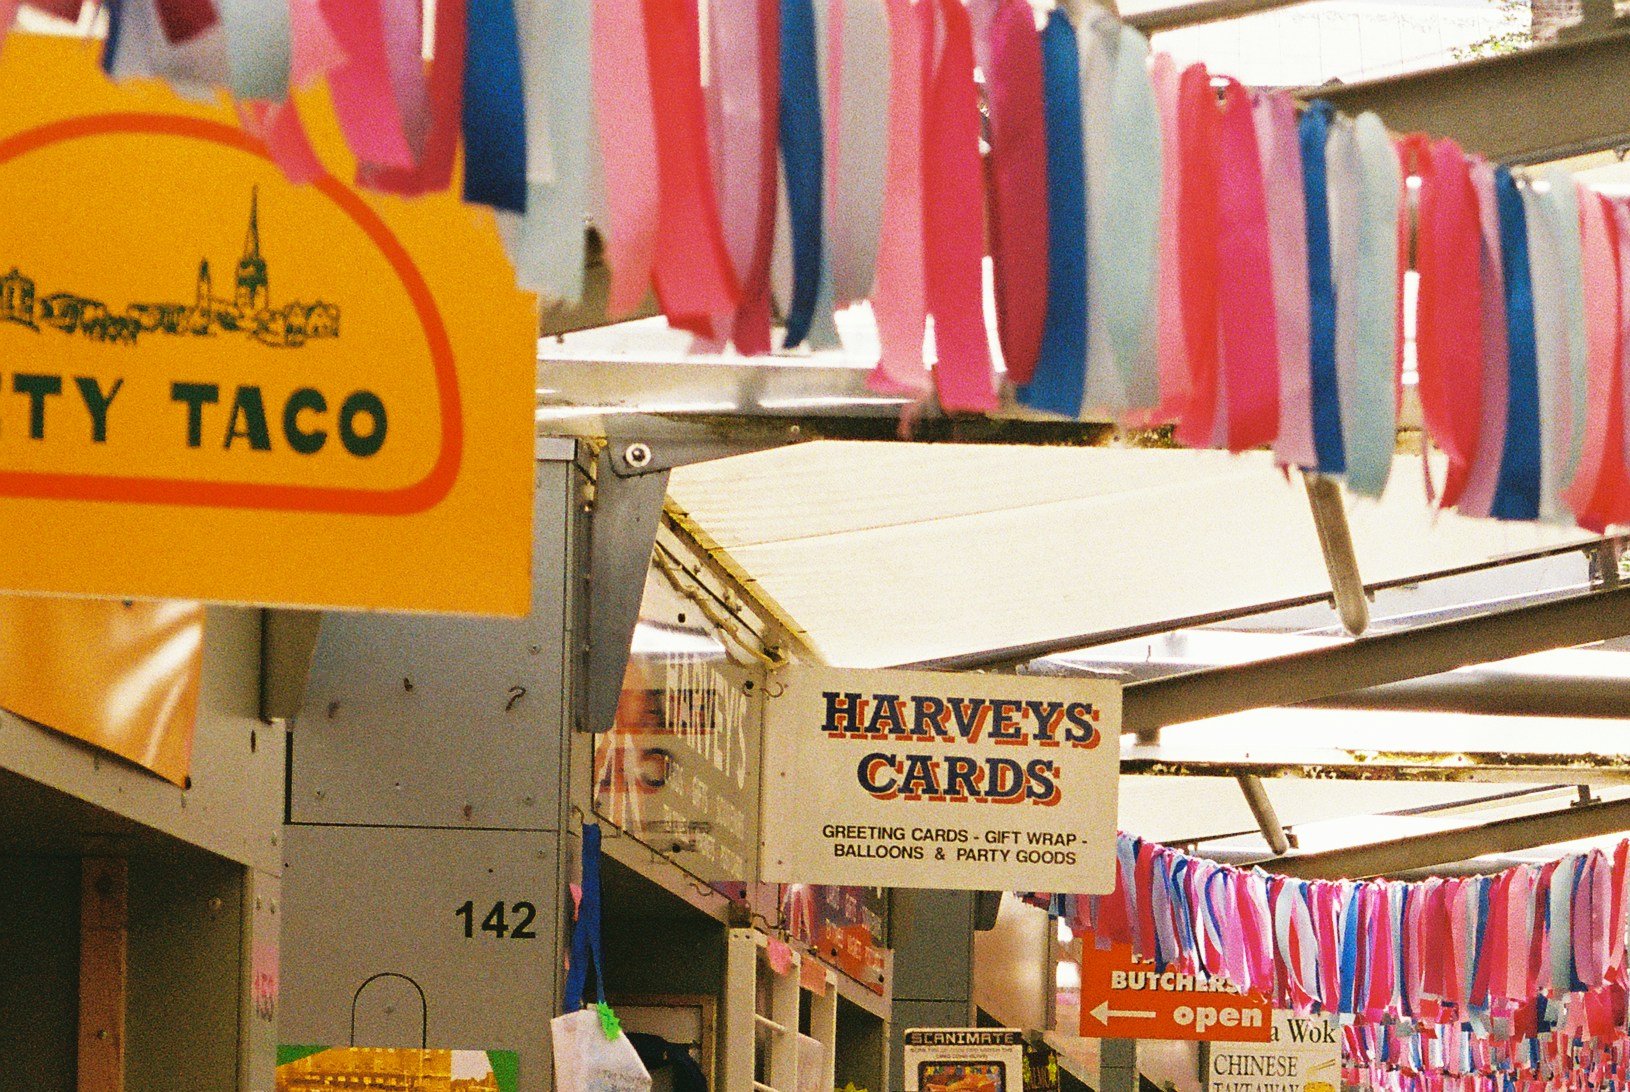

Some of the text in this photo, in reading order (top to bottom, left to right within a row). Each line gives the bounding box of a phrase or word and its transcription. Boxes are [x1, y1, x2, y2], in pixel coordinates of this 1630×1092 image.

[8, 372, 389, 458] TY TACO
[820, 691, 1101, 750] HARVEYS
[857, 752, 1062, 807] CARDS
[822, 824, 904, 842] GREETING
[911, 827, 968, 843] CARDS
[984, 830, 1022, 846] GIFT
[1026, 832, 1077, 848] WRAP
[834, 843, 1076, 865] BALLOONS & PARTY GOODS
[455, 900, 537, 938] 142
[1173, 1005, 1262, 1033] open
[1287, 1018, 1336, 1044] Wok
[911, 1033, 1013, 1044] SCANIMATE
[1213, 1054, 1298, 1077] CHINESE
